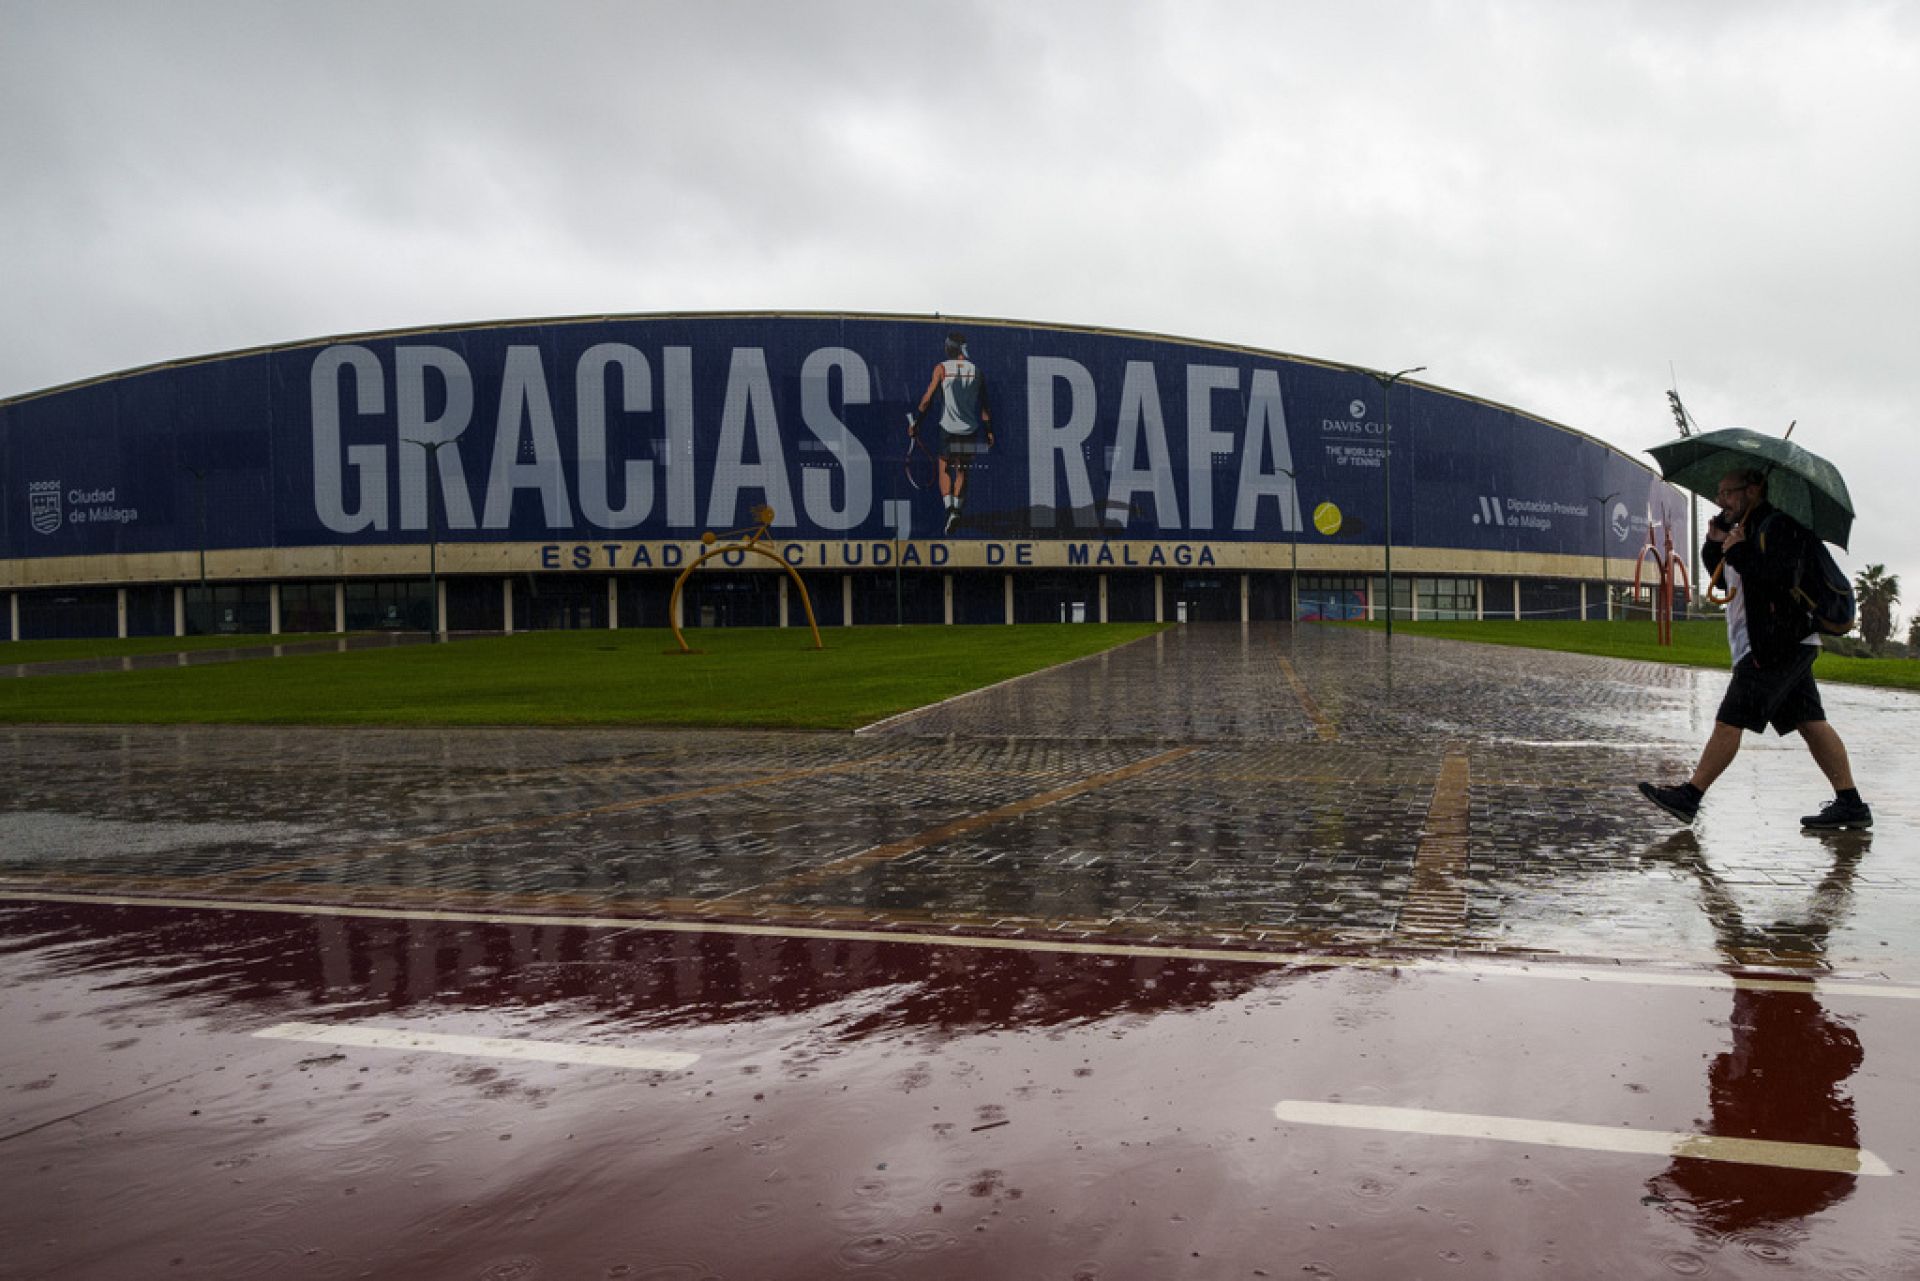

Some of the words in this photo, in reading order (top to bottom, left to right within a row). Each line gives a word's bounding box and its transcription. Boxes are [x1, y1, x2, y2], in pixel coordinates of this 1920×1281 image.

[1322, 419, 1362, 433] DAVIS
[310, 342, 913, 541] GRACIAS,
[1027, 355, 1304, 533] RAFA
[1325, 446, 1343, 456] THE
[1344, 447, 1375, 457] WORLD
[1336, 456, 1349, 466] OF
[1350, 456, 1381, 468] TENNIS
[68, 488, 116, 504] Ciudad
[68, 508, 87, 523] de
[89, 507, 138, 524] Málaga
[1506, 498, 1551, 513] Diputación
[1552, 502, 1588, 517] Provincial
[1506, 515, 1519, 526] de
[541, 543, 746, 568] ESTADIO
[783, 543, 949, 566] CIUDAD
[986, 543, 1033, 566] DE
[1068, 538, 1216, 566] MÁLAGA
